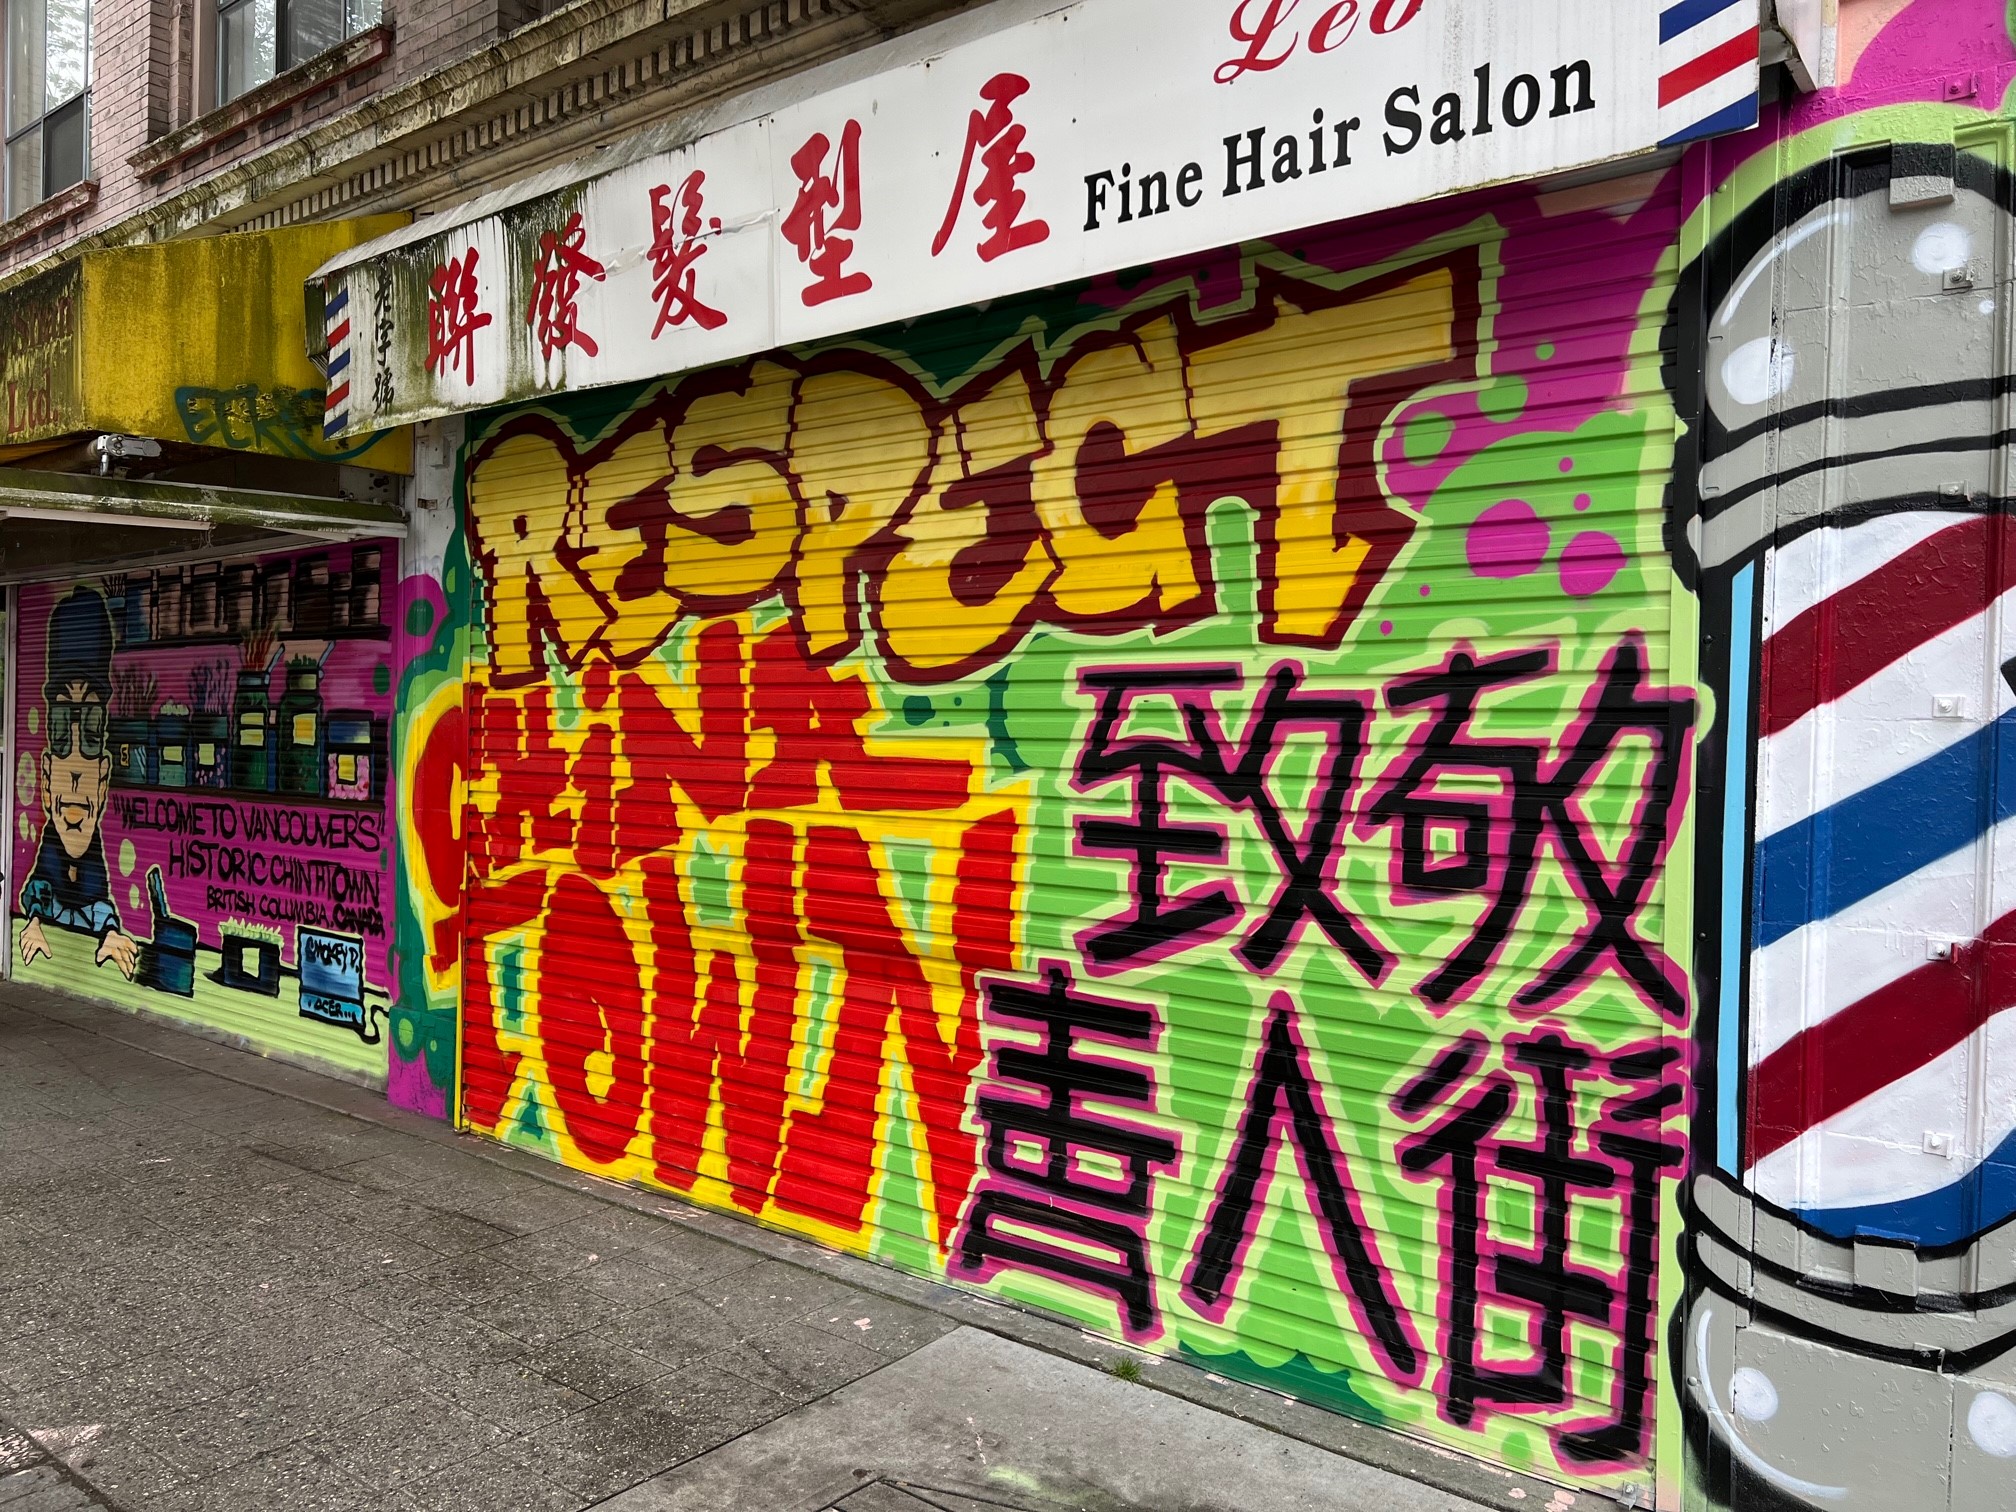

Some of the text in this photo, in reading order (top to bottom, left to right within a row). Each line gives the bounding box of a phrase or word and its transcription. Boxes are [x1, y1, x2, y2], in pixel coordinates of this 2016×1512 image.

[1083, 58, 1596, 232] Fine Hair Salon
[7, 366, 60, 434] Ltd.
[467, 250, 1480, 687] RESPECT
[203, 803, 237, 840] TO
[403, 610, 990, 930] CHINA
[1072, 632, 1697, 1020] 致敬
[168, 838, 267, 885] HISTORIC
[206, 885, 256, 917] BRITISH
[430, 805, 1025, 1255] TOWN
